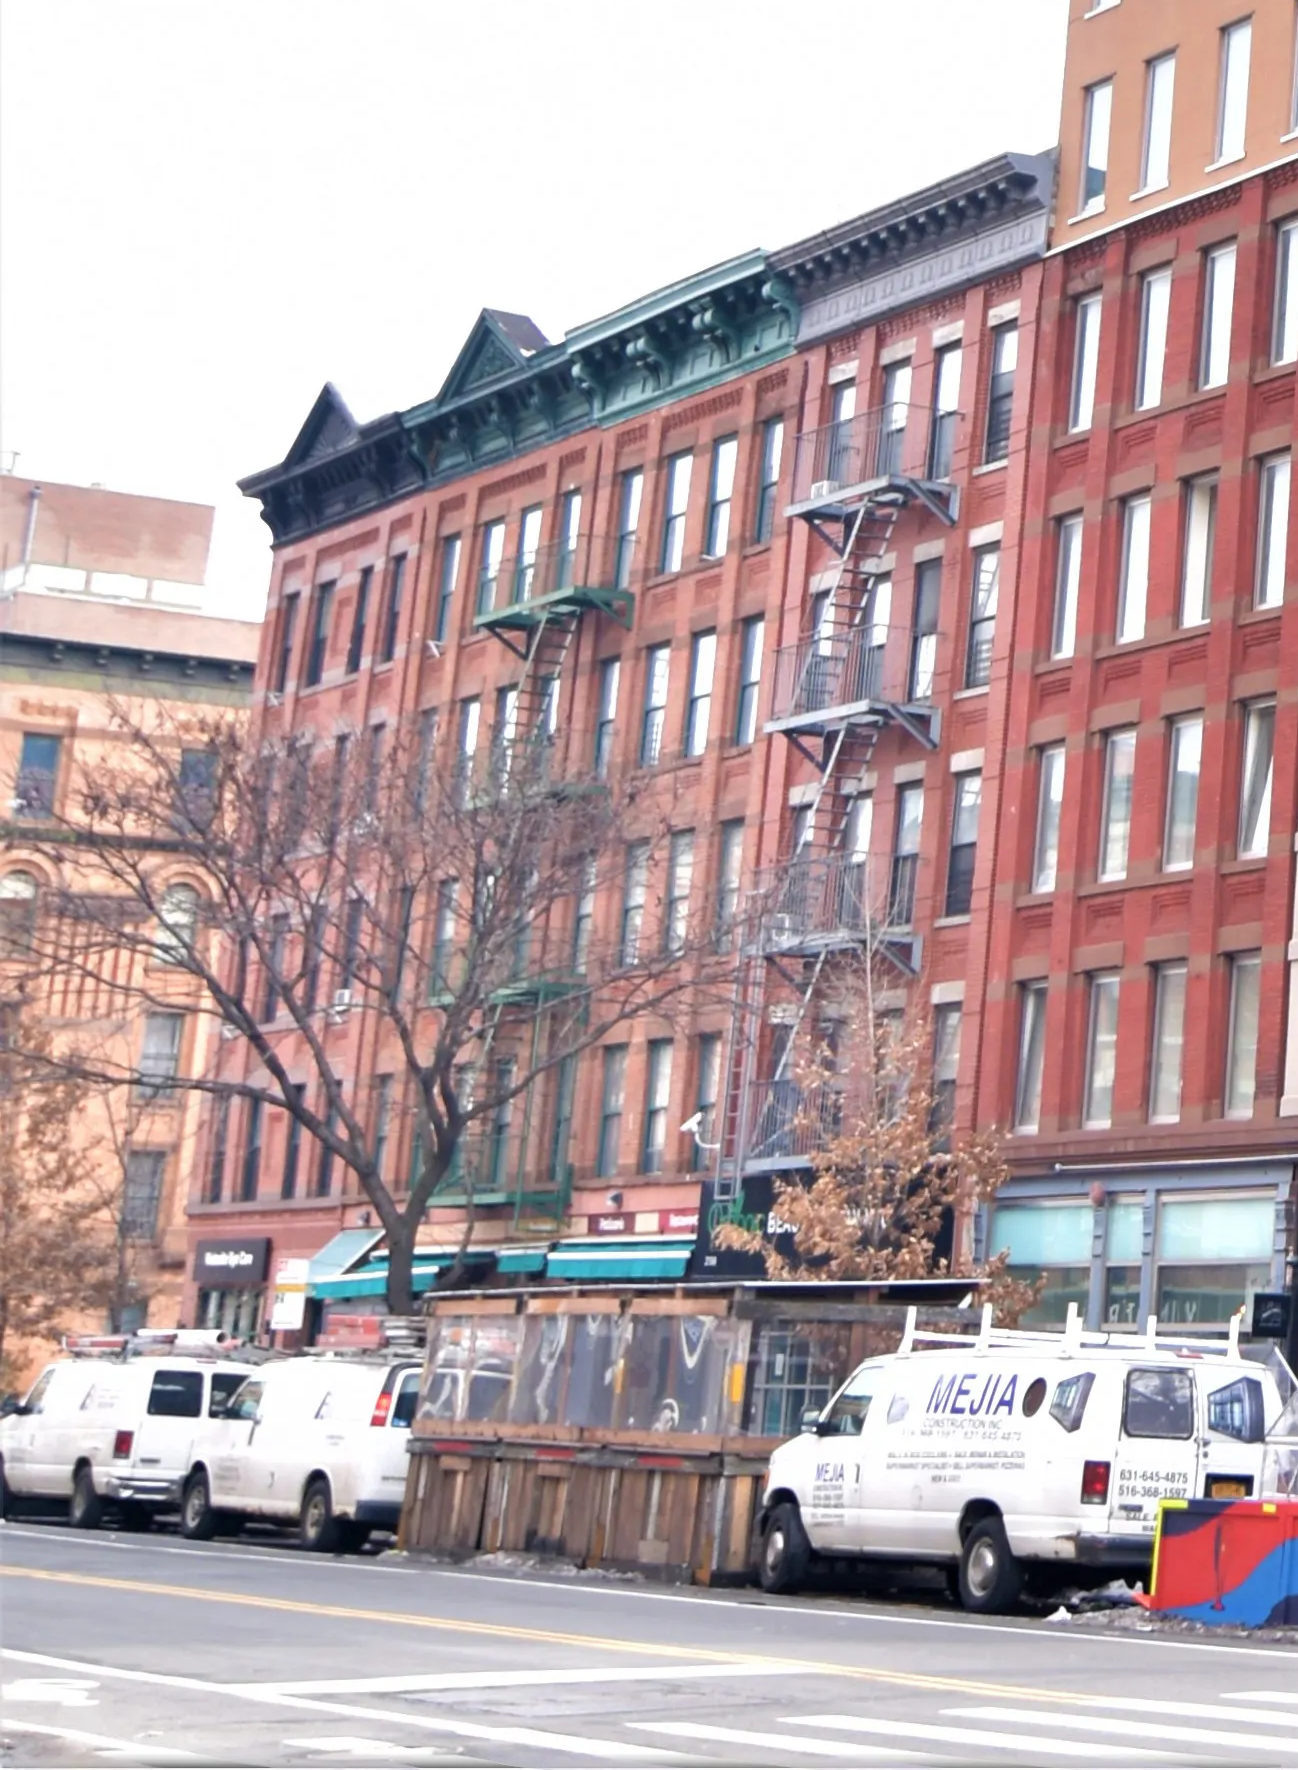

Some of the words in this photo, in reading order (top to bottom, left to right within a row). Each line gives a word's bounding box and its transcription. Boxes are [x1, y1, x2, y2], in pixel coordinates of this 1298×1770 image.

[925, 1373, 1019, 1416] MEJIA
[923, 1418, 986, 1430] CONSTRUCTION
[814, 1462, 845, 1482] MEJIA
[1119, 1469, 1188, 1485] 631-645-4875
[1118, 1484, 1188, 1499] 516-368-1597
